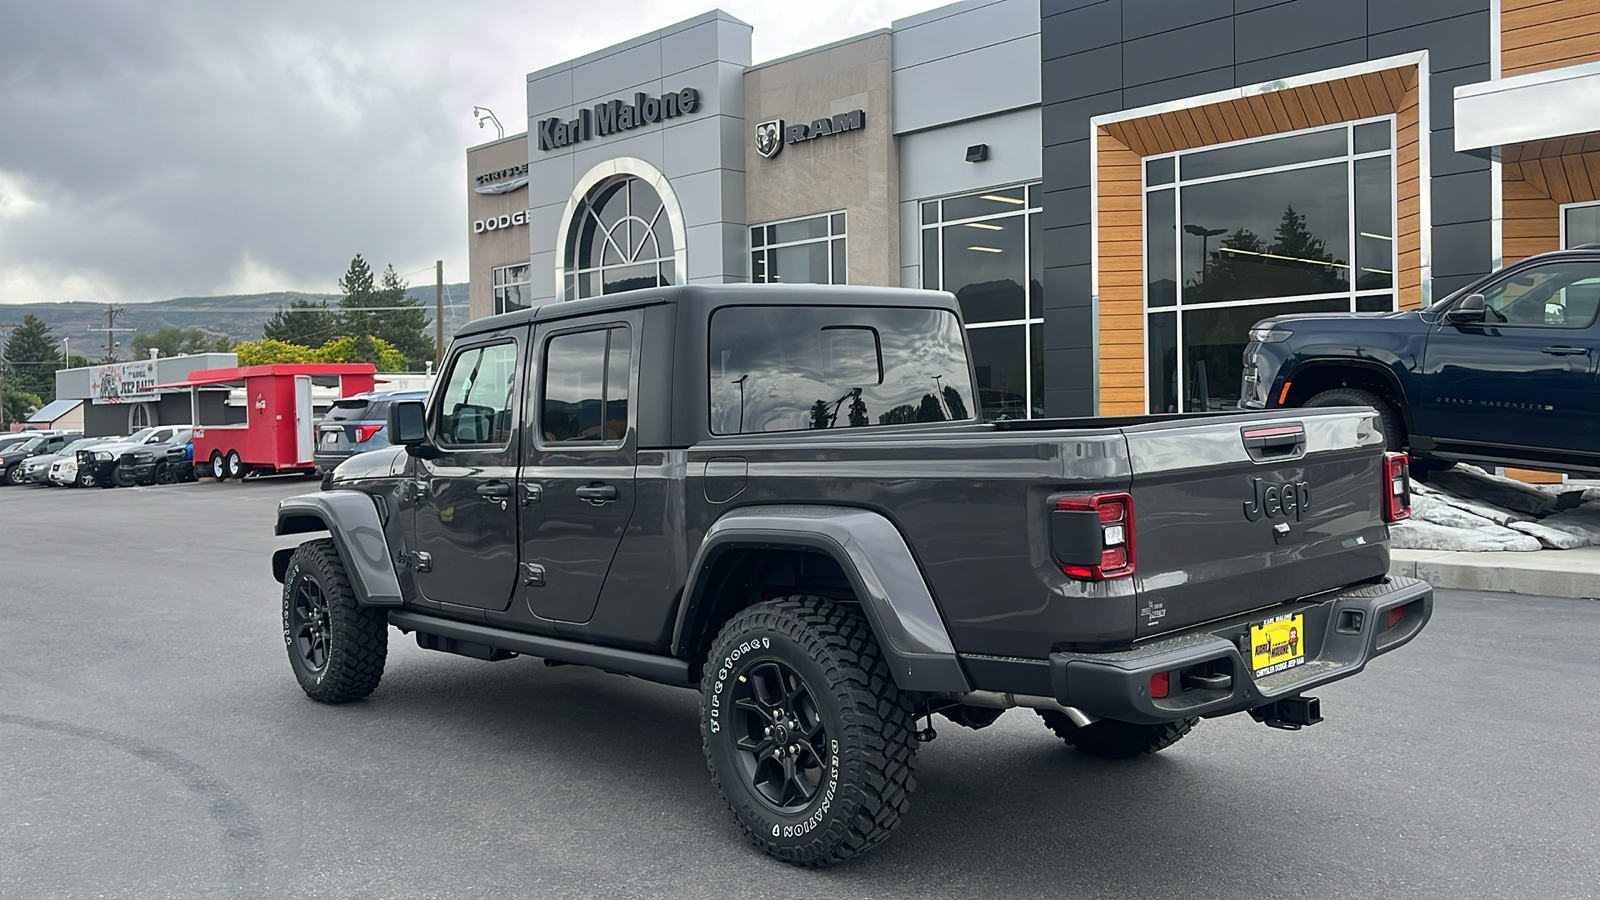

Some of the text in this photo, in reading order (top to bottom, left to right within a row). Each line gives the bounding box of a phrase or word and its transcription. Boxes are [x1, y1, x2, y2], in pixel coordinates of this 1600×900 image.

[538, 87, 700, 151] Karl Malone
[785, 109, 865, 144] RAM
[476, 163, 528, 184] CHRYSLE
[120, 381, 135, 394] JEEP
[1436, 396, 1543, 410] GRAND WAGONEER
[1243, 477, 1311, 522] Jeep
[1276, 613, 1292, 621] MALONE
[1256, 656, 1305, 678] CHRYSLER DODGE JEEP RAM
[784, 739, 840, 837] DESTINATION
